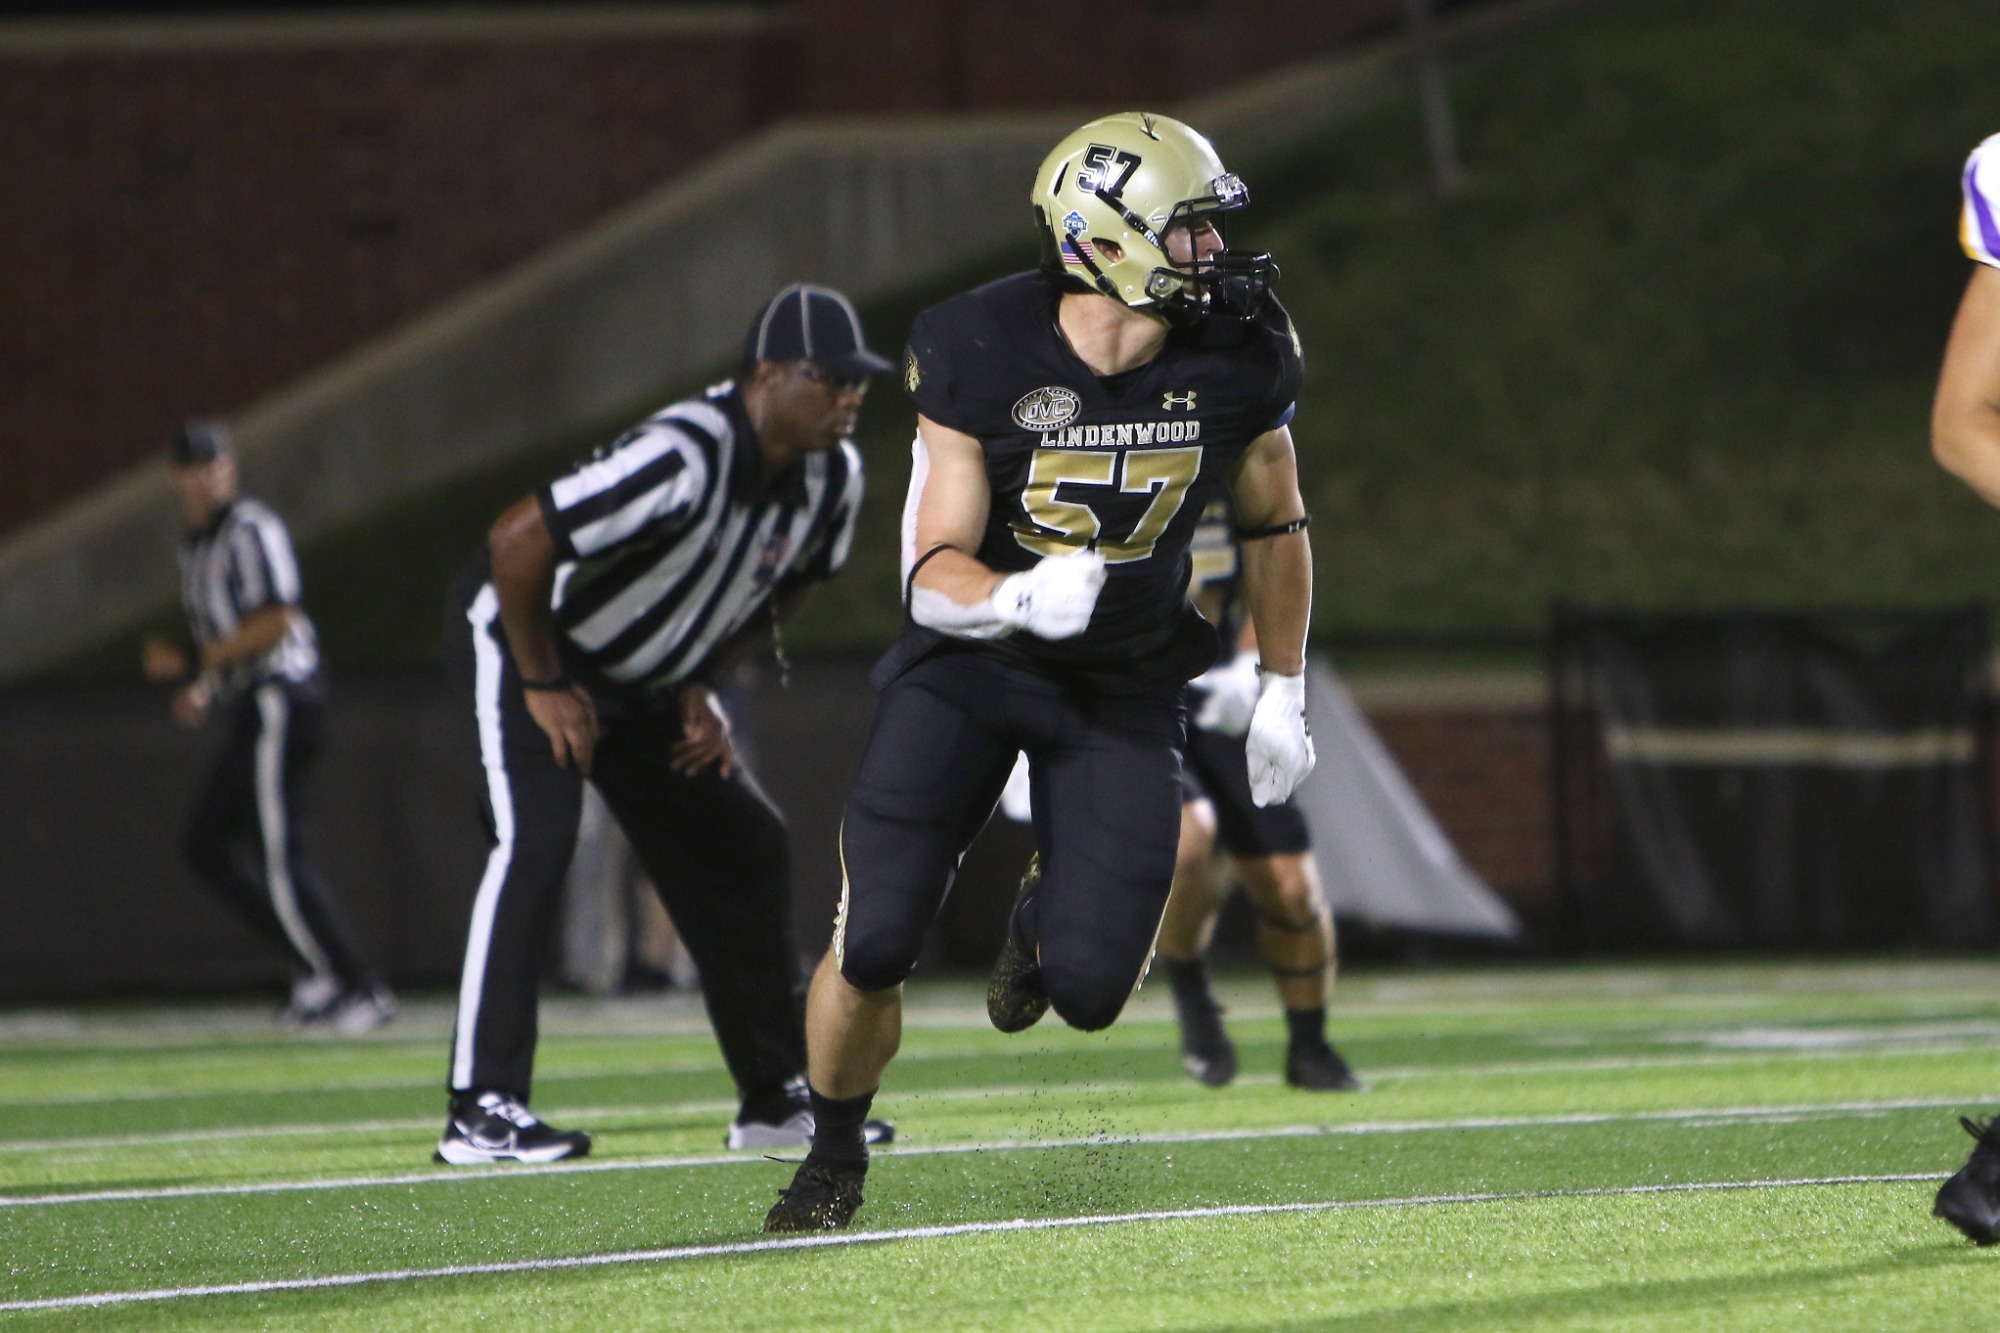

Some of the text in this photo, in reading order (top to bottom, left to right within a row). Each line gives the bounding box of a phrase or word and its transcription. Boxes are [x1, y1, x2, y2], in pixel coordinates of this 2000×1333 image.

[1076, 142, 1142, 199] 57
[1026, 399, 1068, 420] OVC
[1040, 420, 1201, 447] LINDENWOOD
[1013, 445, 1204, 565] 57
